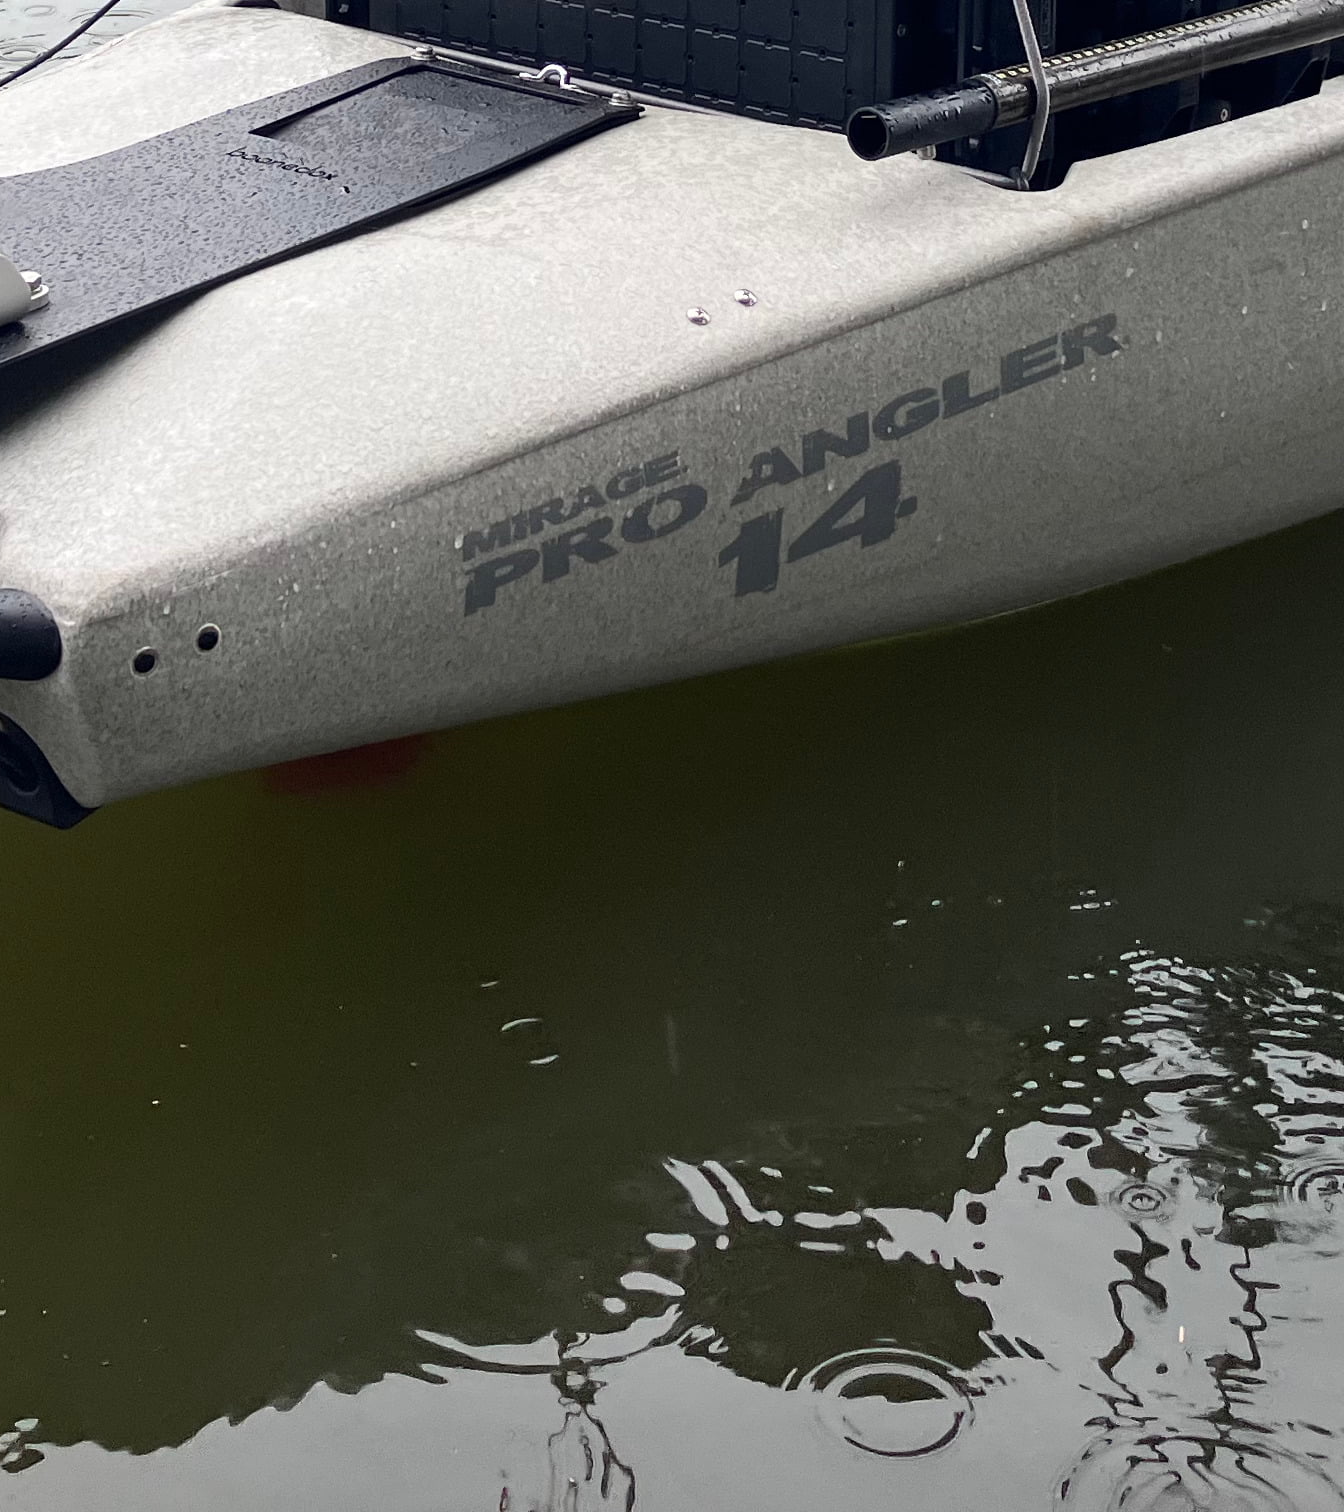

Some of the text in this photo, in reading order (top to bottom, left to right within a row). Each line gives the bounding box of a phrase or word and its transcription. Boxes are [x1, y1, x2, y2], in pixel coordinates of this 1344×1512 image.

[462, 449, 685, 562] MIRAGE
[463, 312, 1124, 616] PRO ANGLER
[719, 459, 918, 597] 14
